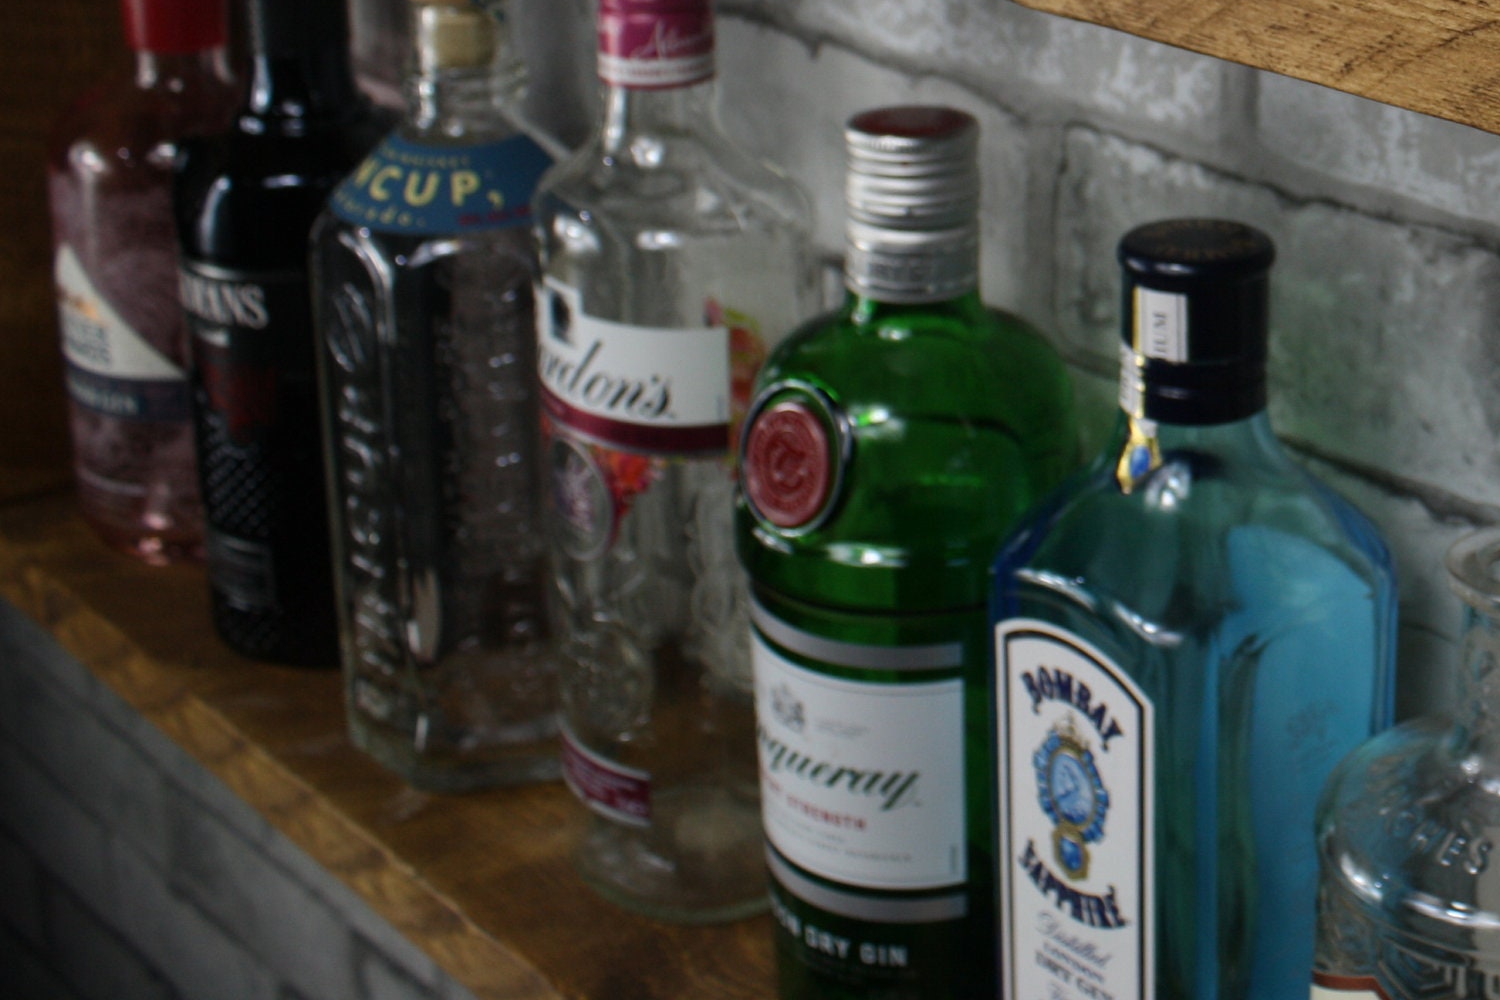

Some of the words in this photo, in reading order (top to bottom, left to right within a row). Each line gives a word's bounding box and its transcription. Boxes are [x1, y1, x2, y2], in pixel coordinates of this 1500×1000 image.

[1021, 664, 1125, 752] BOMBAY
[1018, 838, 1128, 930] SAPPHIRE
[803, 924, 852, 960] DRY
[858, 941, 910, 968] GIN
